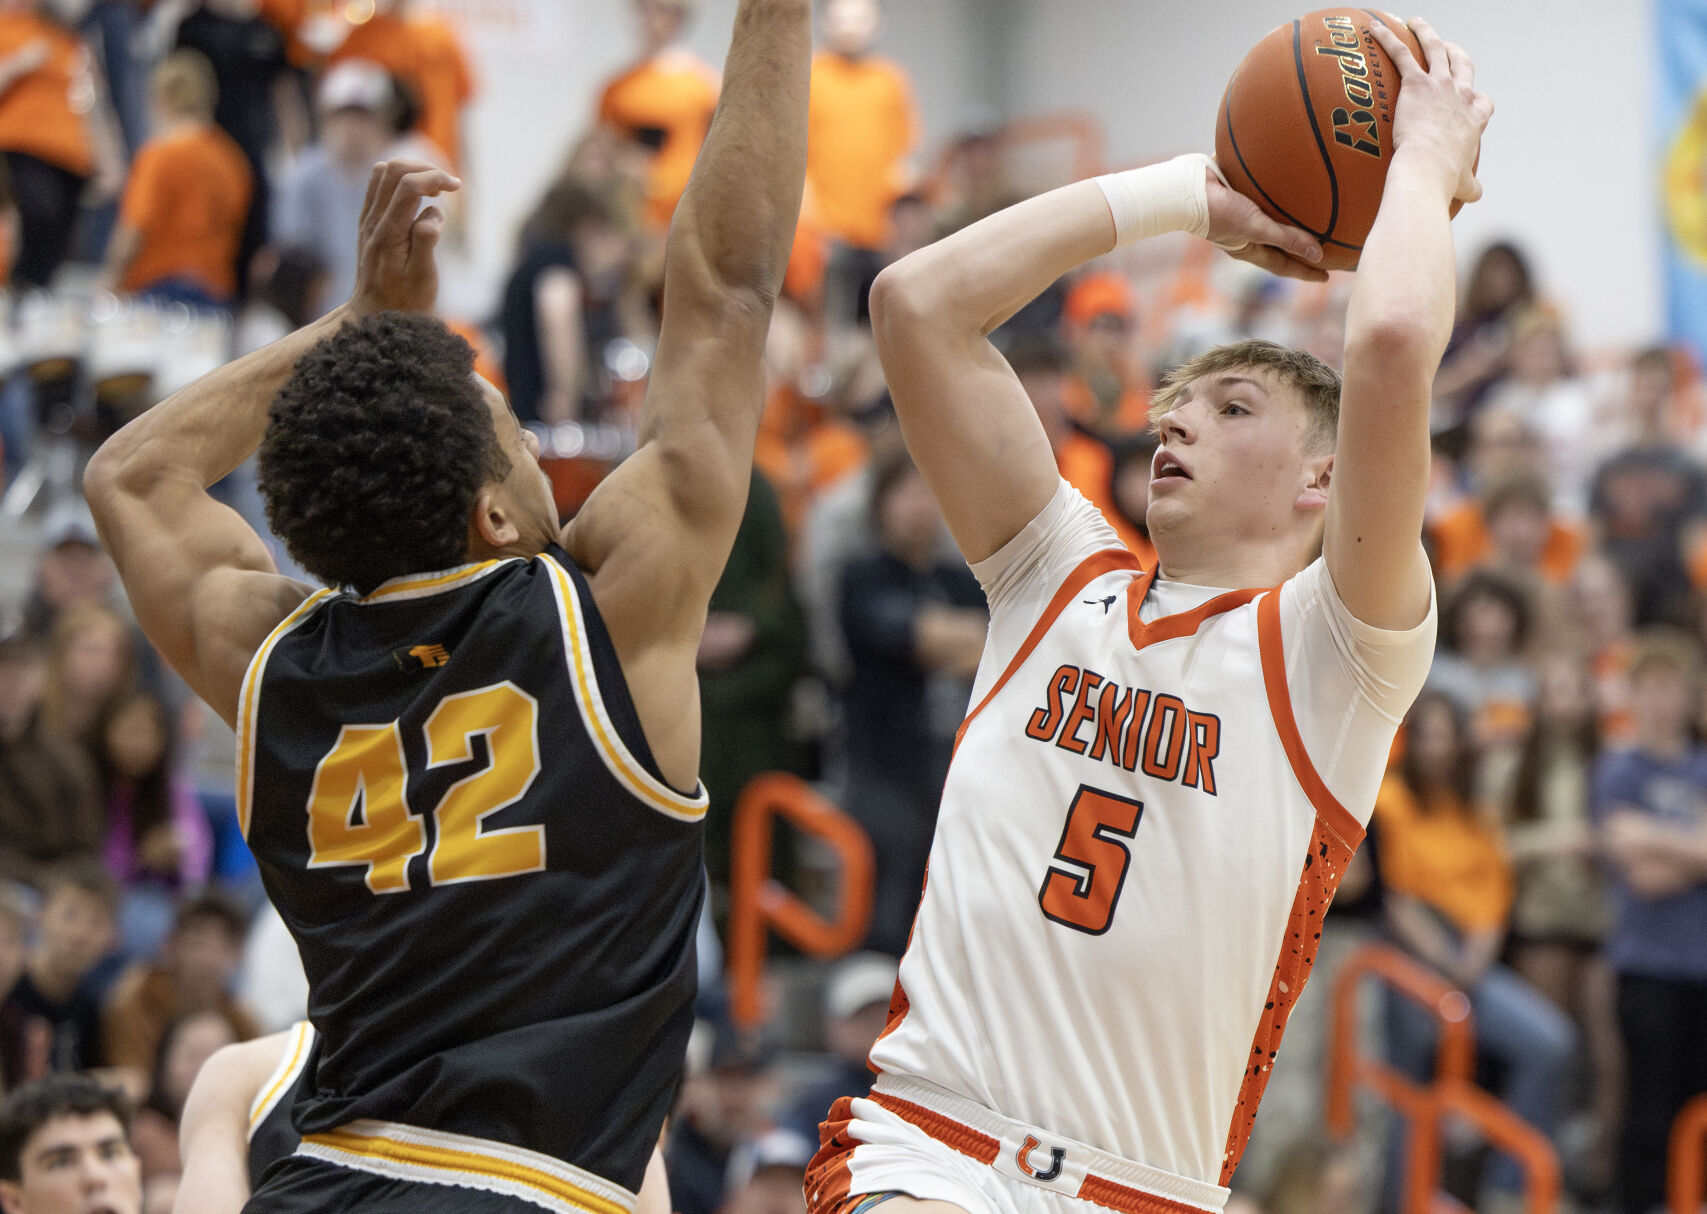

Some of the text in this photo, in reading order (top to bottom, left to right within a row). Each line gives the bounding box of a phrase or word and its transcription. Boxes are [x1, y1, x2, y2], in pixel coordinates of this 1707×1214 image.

[1315, 16, 1381, 159] Baden
[306, 680, 546, 895] 42
[1025, 664, 1221, 796] SENIOR
[1038, 783, 1144, 936] 5
